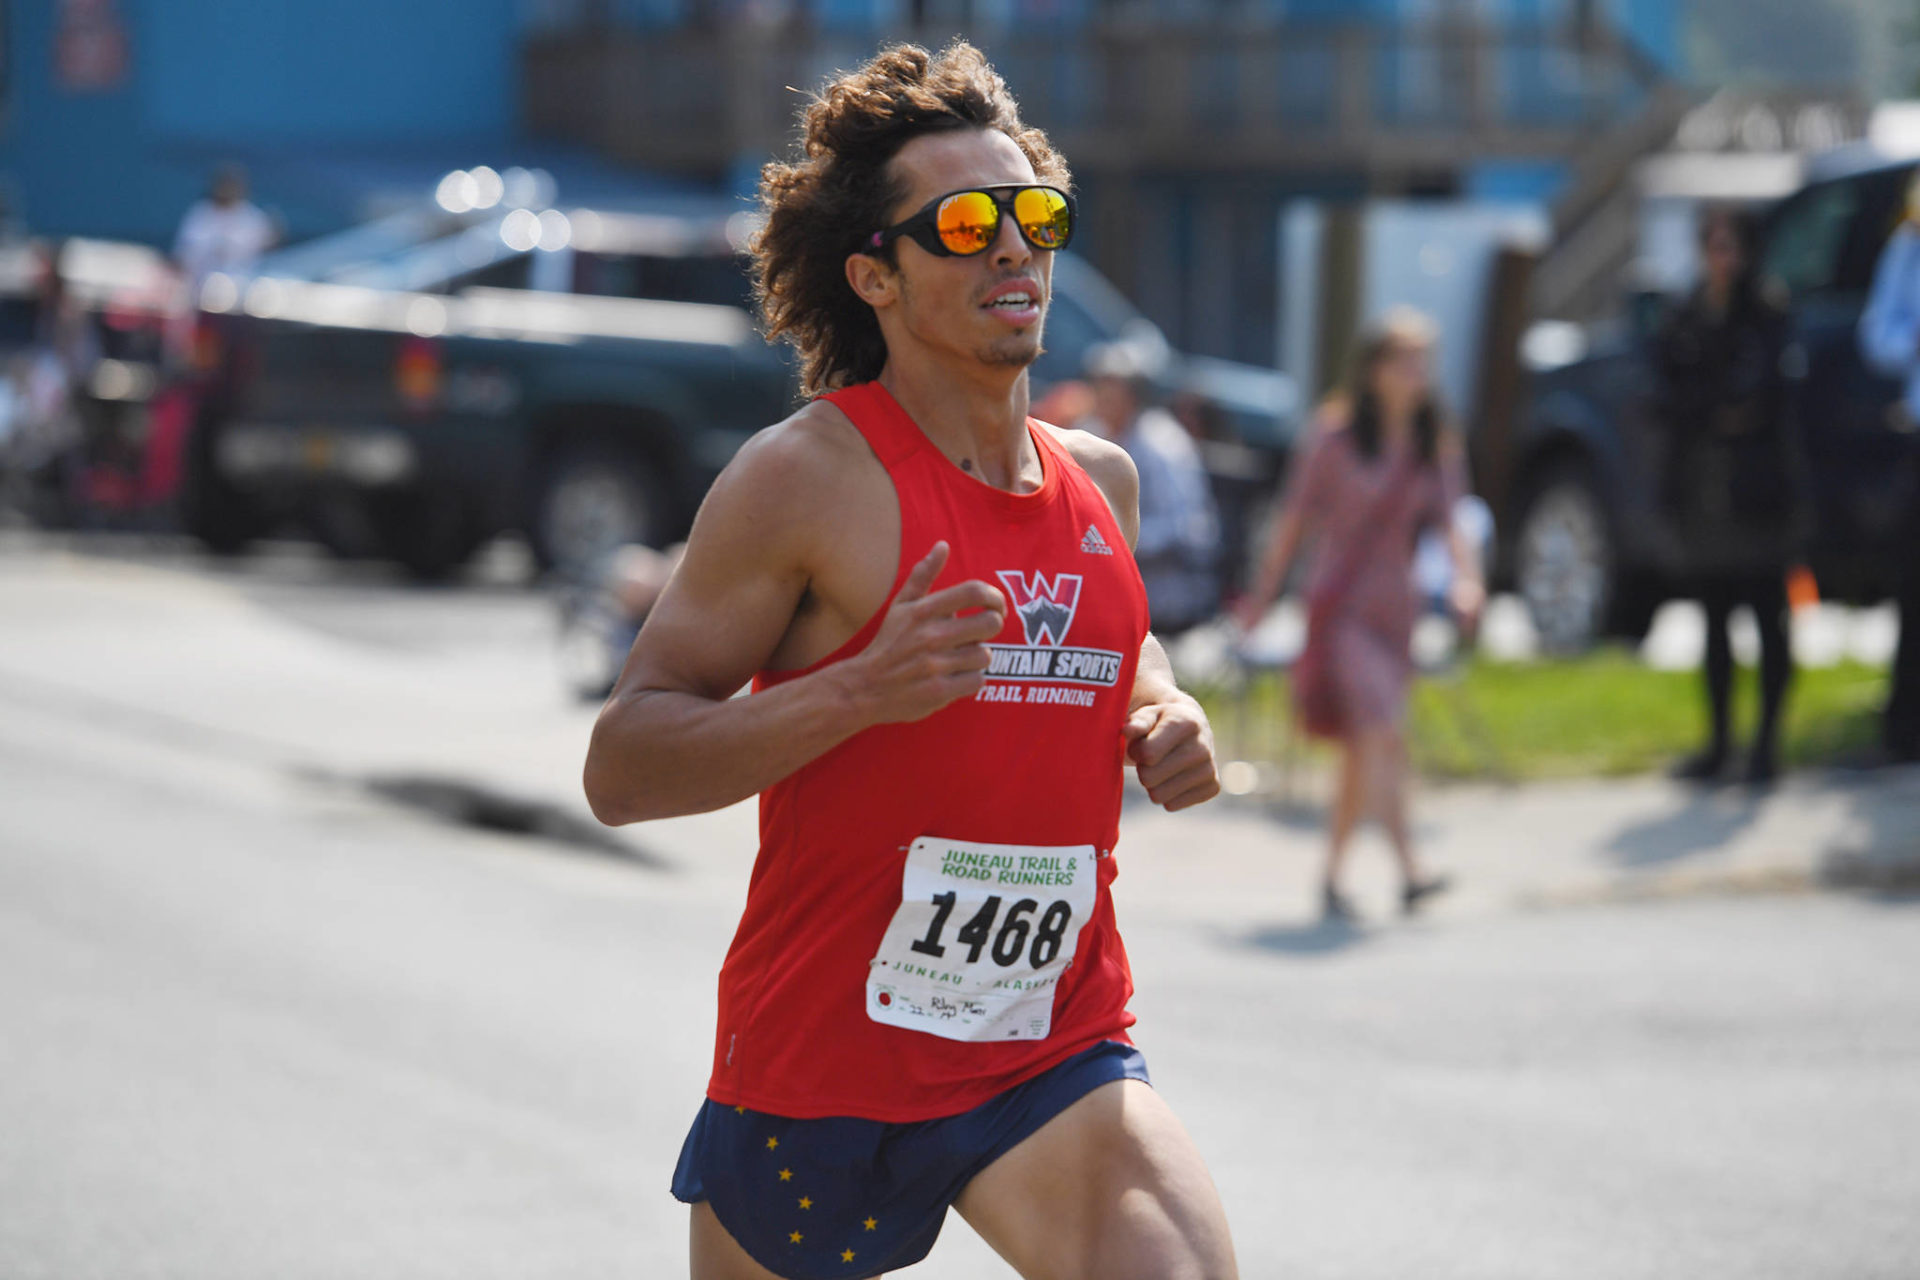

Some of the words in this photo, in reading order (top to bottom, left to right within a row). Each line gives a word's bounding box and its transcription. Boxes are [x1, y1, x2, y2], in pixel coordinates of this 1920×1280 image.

[1080, 543, 1113, 556] adidas
[988, 649, 1051, 675] UNTAIN
[1055, 652, 1118, 681] SPORTS
[975, 685, 1022, 702] TRAIL
[1025, 687, 1096, 707] RUNNING
[941, 850, 1013, 870] JUNEAU
[1019, 856, 1062, 871] TRAIL
[1066, 857, 1077, 870] &
[941, 863, 992, 881] ROAD
[998, 869, 1075, 886] RUNNERS
[910, 891, 1072, 970] 1468
[893, 962, 964, 986] JUNEAU
